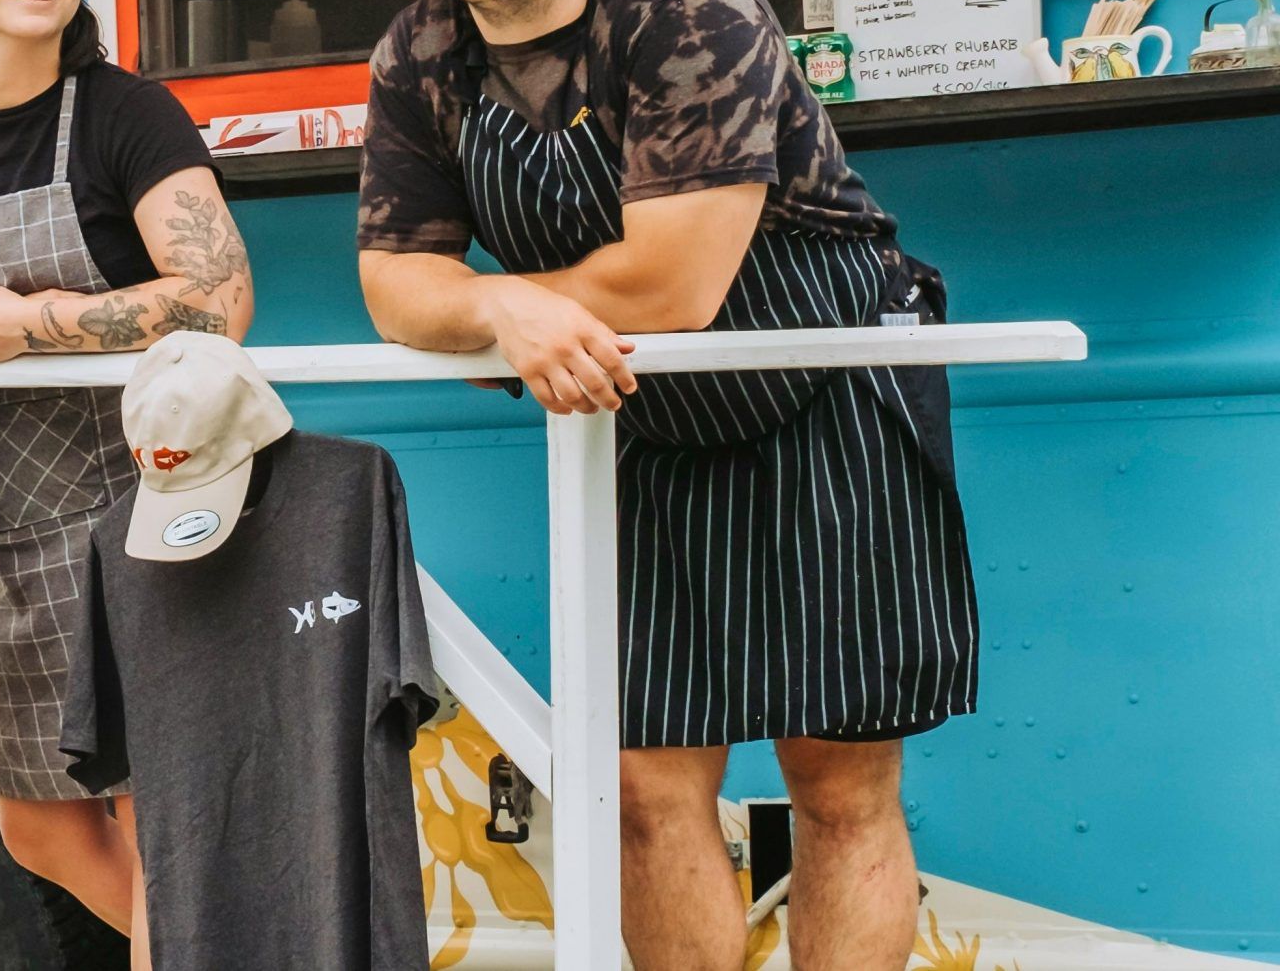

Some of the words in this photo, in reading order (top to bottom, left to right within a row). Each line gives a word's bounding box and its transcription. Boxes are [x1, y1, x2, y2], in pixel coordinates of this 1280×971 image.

[858, 43, 948, 63] STRAWBERRY
[955, 39, 1018, 54] RHUBARB
[814, 69, 833, 78] DRY
[860, 69, 880, 81] PIE
[897, 63, 949, 78] WHIPPED
[955, 58, 995, 72] CREAM
